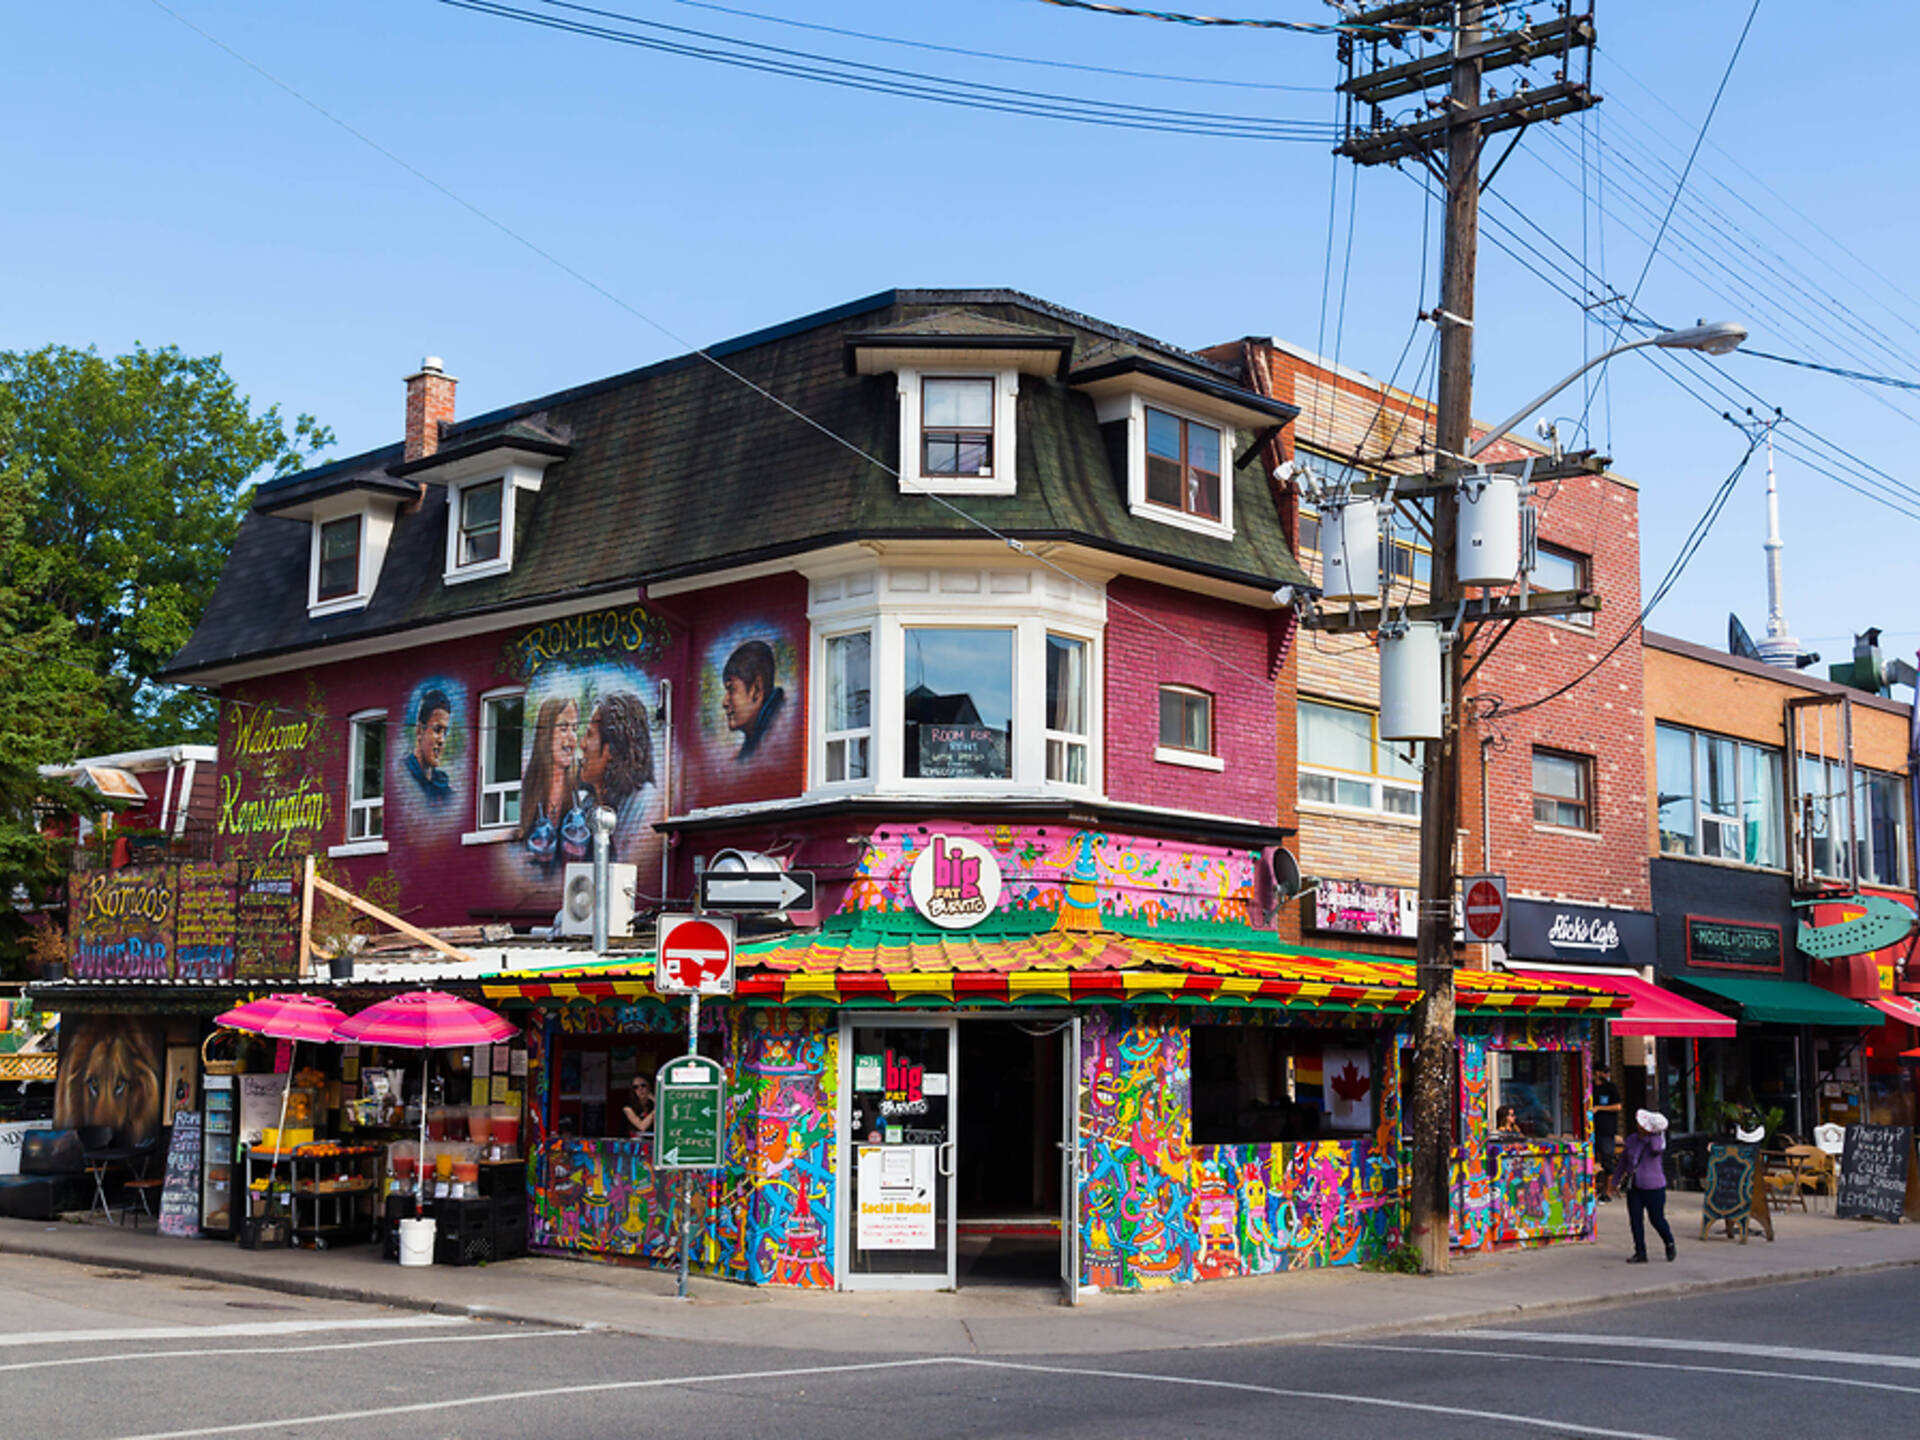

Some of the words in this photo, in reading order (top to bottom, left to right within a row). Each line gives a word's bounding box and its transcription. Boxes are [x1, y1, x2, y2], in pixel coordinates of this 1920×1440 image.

[231, 704, 314, 757] Welcome
[217, 771, 323, 858] Kensington
[934, 837, 982, 899] big
[127, 936, 168, 978] BAR
[884, 1048, 925, 1102] big
[1839, 1191, 1901, 1214] LEMONADE
